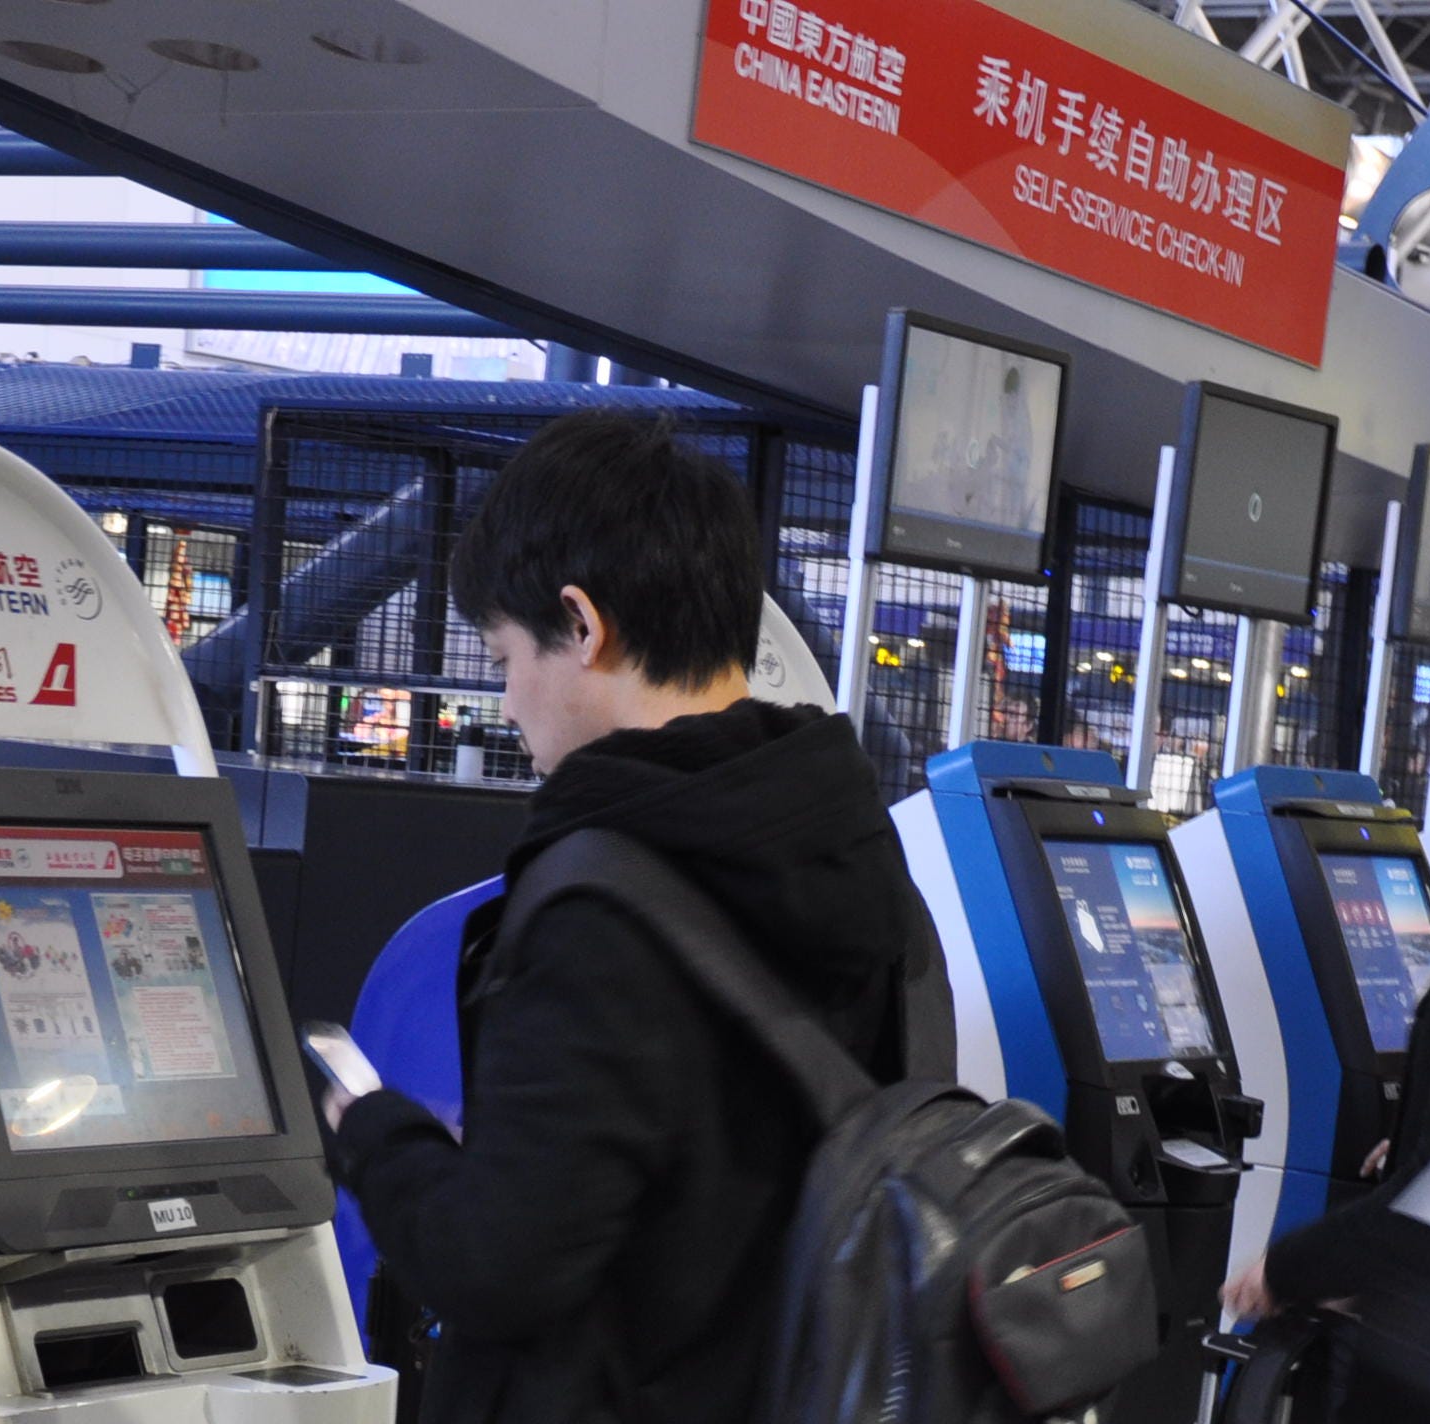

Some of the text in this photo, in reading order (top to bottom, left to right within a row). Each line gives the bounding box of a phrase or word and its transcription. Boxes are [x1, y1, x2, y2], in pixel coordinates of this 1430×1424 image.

[735, 42, 900, 136] CHINA EASTERN
[739, 0, 906, 97] 中國東方航空
[973, 53, 1289, 245] 乘机手续自助办理区
[1014, 164, 1244, 287] SELF-SERVICE CHECK-IN
[153, 1205, 192, 1225] MU 10
